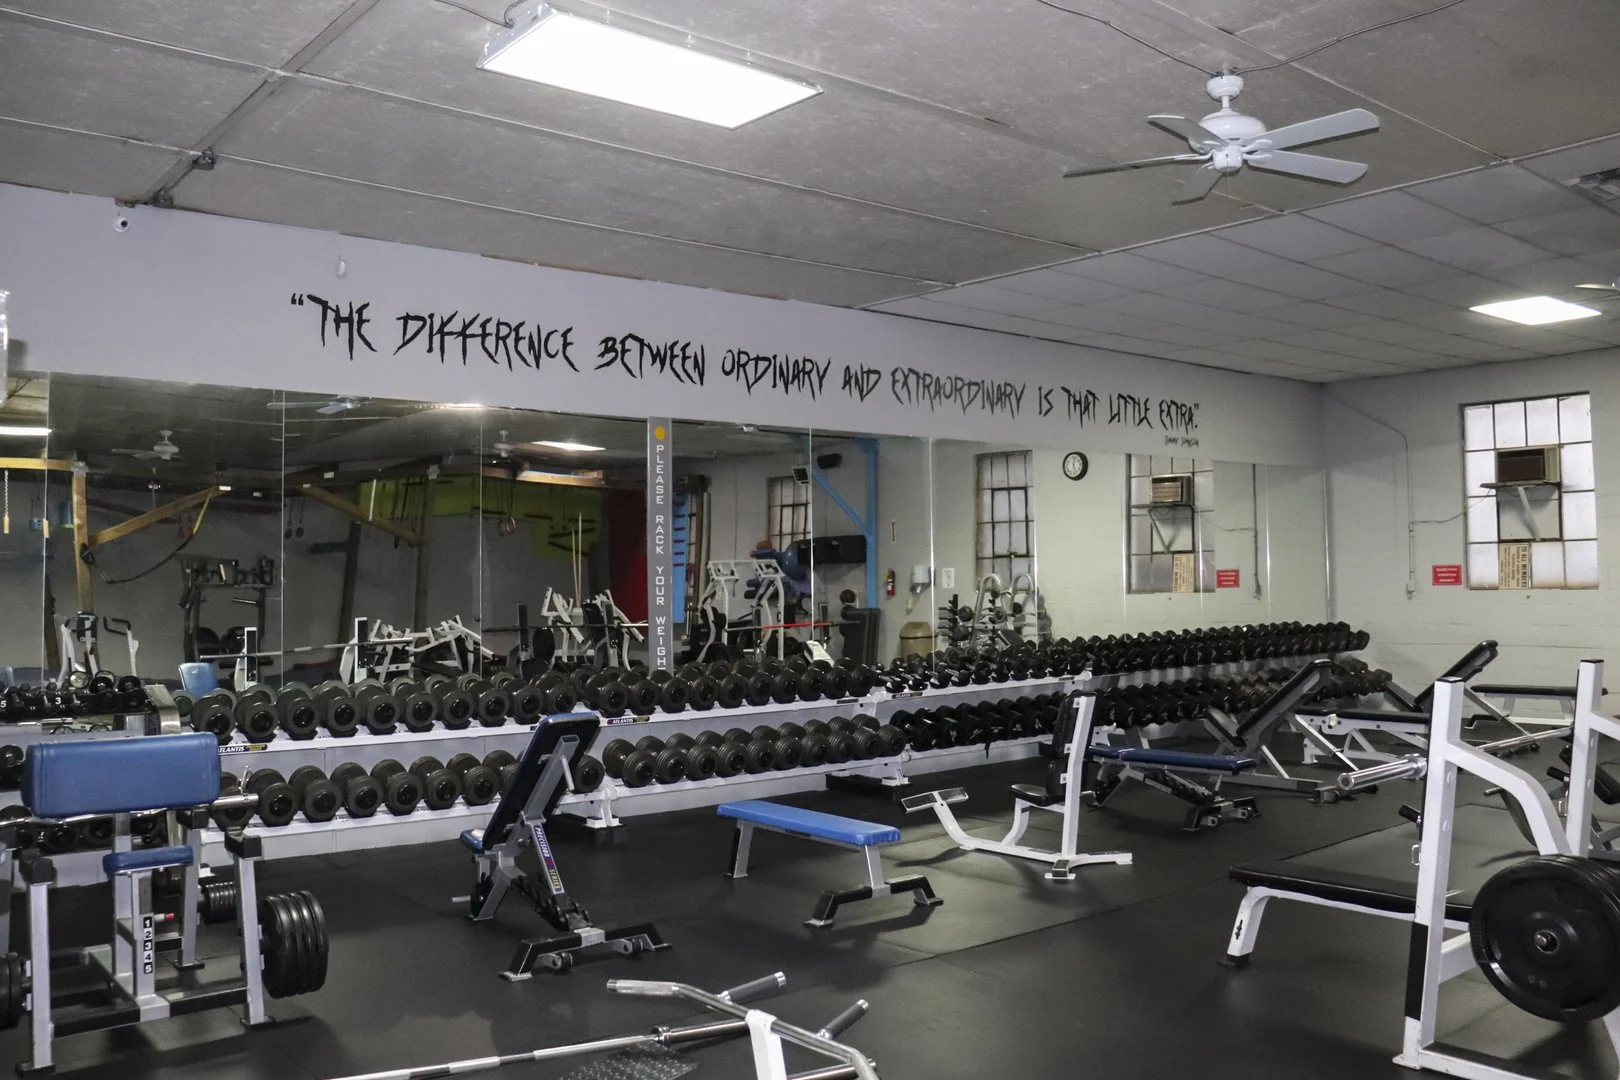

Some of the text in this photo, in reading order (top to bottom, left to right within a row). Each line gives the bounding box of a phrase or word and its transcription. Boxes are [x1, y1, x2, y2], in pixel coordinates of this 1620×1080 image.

[393, 310, 580, 373] DIFFERENCE
[594, 333, 706, 386] BETWEEN
[721, 347, 831, 402] ORDINARY
[841, 362, 882, 403] AND
[890, 367, 1027, 419] EXTRAORDINARY
[1038, 386, 1055, 417] IS
[1061, 385, 1101, 429] THAT
[1108, 393, 1154, 430] LITTLE
[655, 444, 667, 670] PLEASE RACK YOUR WEIGH
[55, 697, 61, 705] 3
[145, 919, 150, 927] 1
[145, 931, 151, 939] 2
[145, 953, 151, 961] 4
[145, 964, 152, 973] 5
